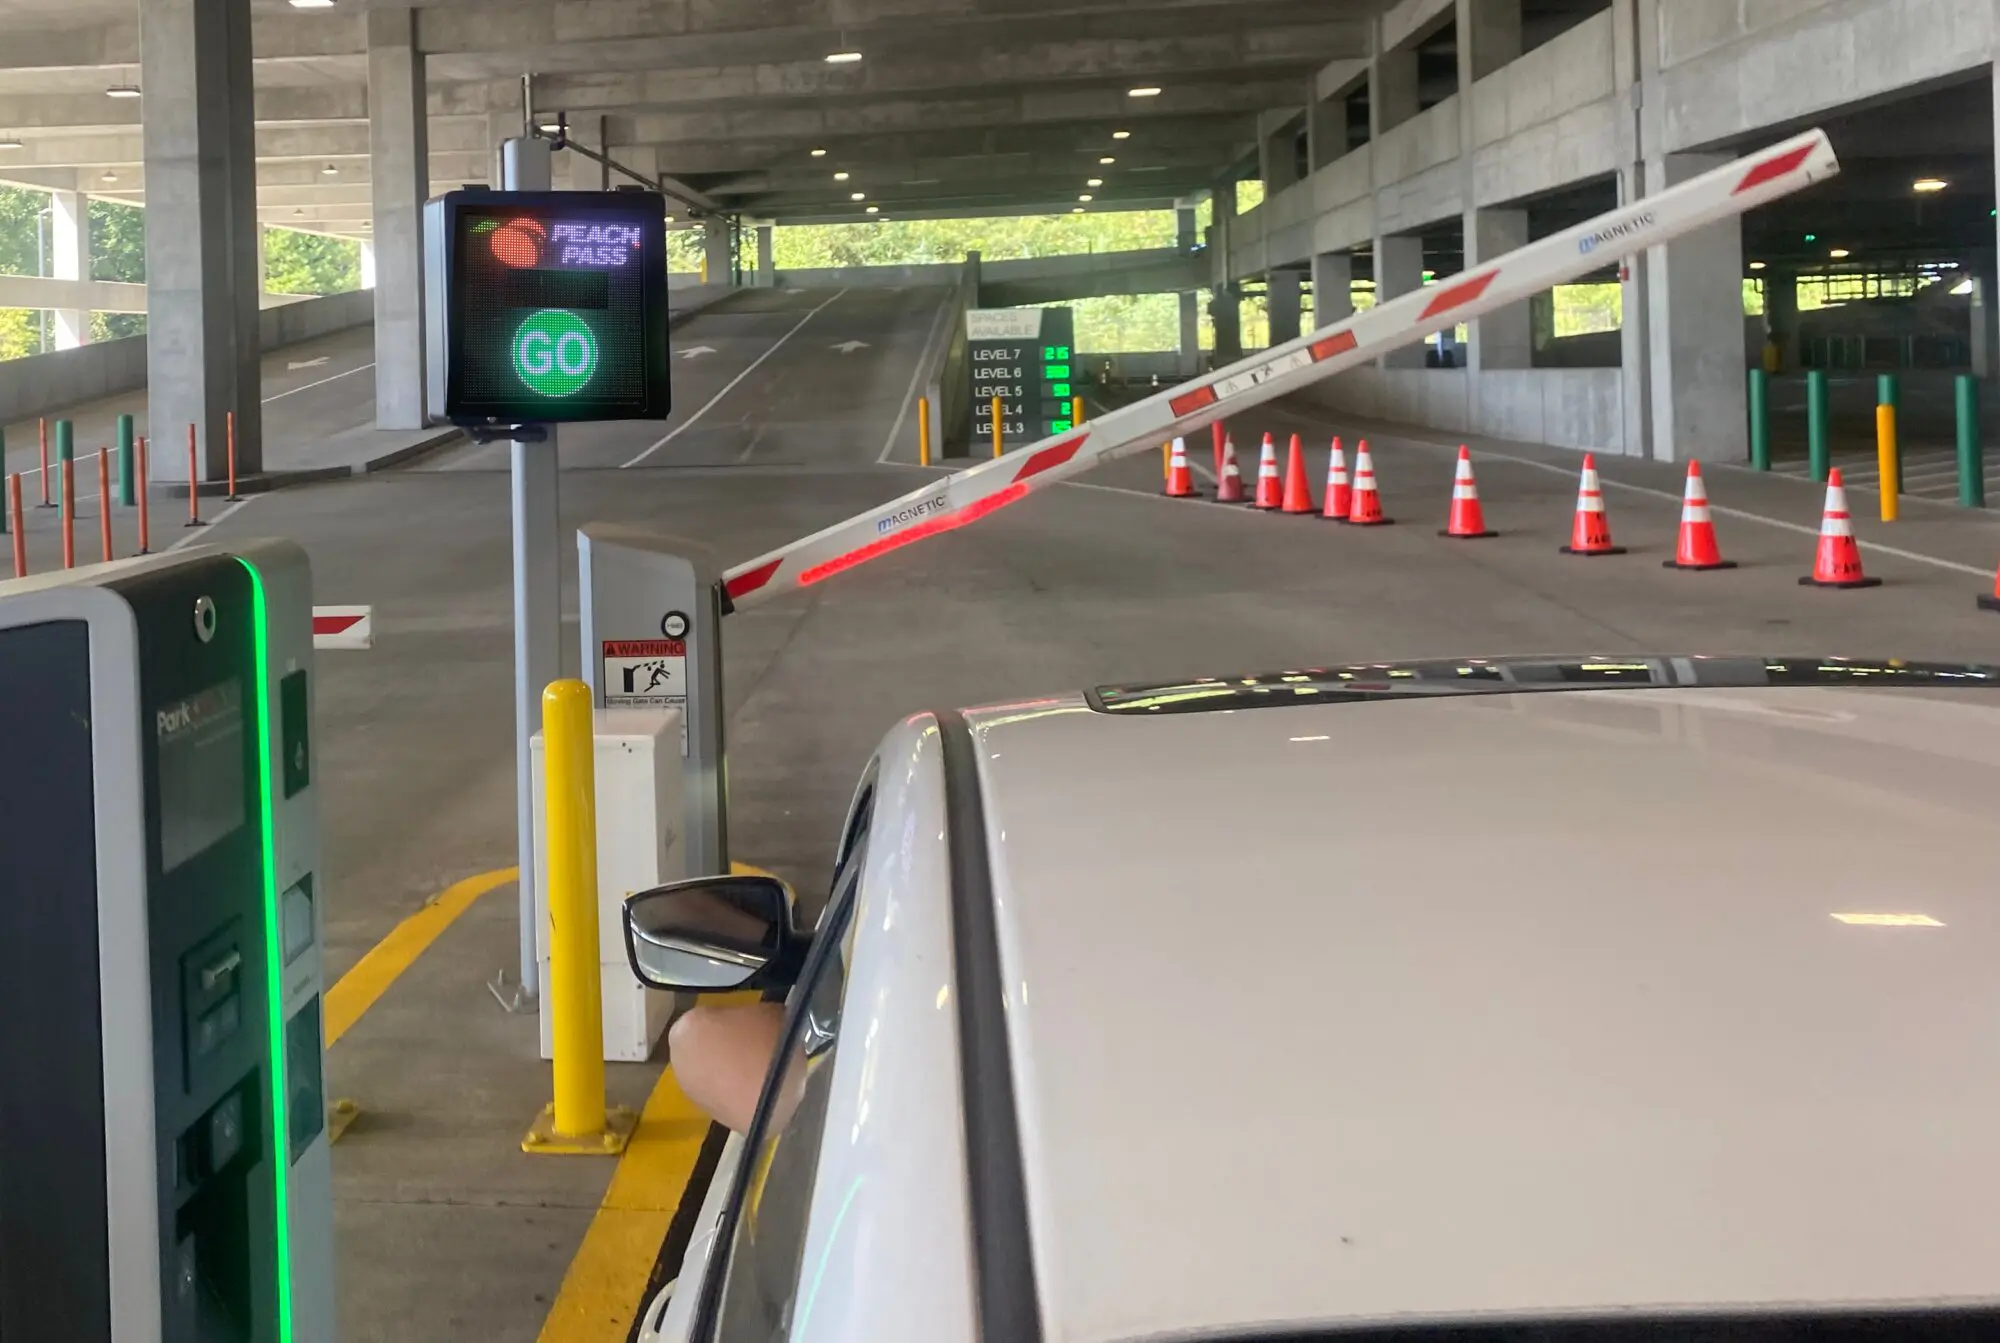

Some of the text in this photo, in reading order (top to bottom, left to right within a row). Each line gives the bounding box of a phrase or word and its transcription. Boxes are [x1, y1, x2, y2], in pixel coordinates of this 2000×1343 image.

[551, 224, 641, 244] PEACH
[561, 246, 628, 265] PASS
[970, 312, 1018, 323] SPACES
[971, 324, 1034, 337] AVAILABLE
[520, 331, 591, 375] GO
[973, 349, 1021, 360] LEVEL 7
[974, 367, 1022, 379] LEVEL 6
[974, 386, 1023, 397] LEVEL 5
[975, 404, 1023, 416] LEEL 4
[976, 422, 1024, 434] LEEL 3
[617, 642, 684, 655] WARNING
[157, 702, 191, 736] Park
